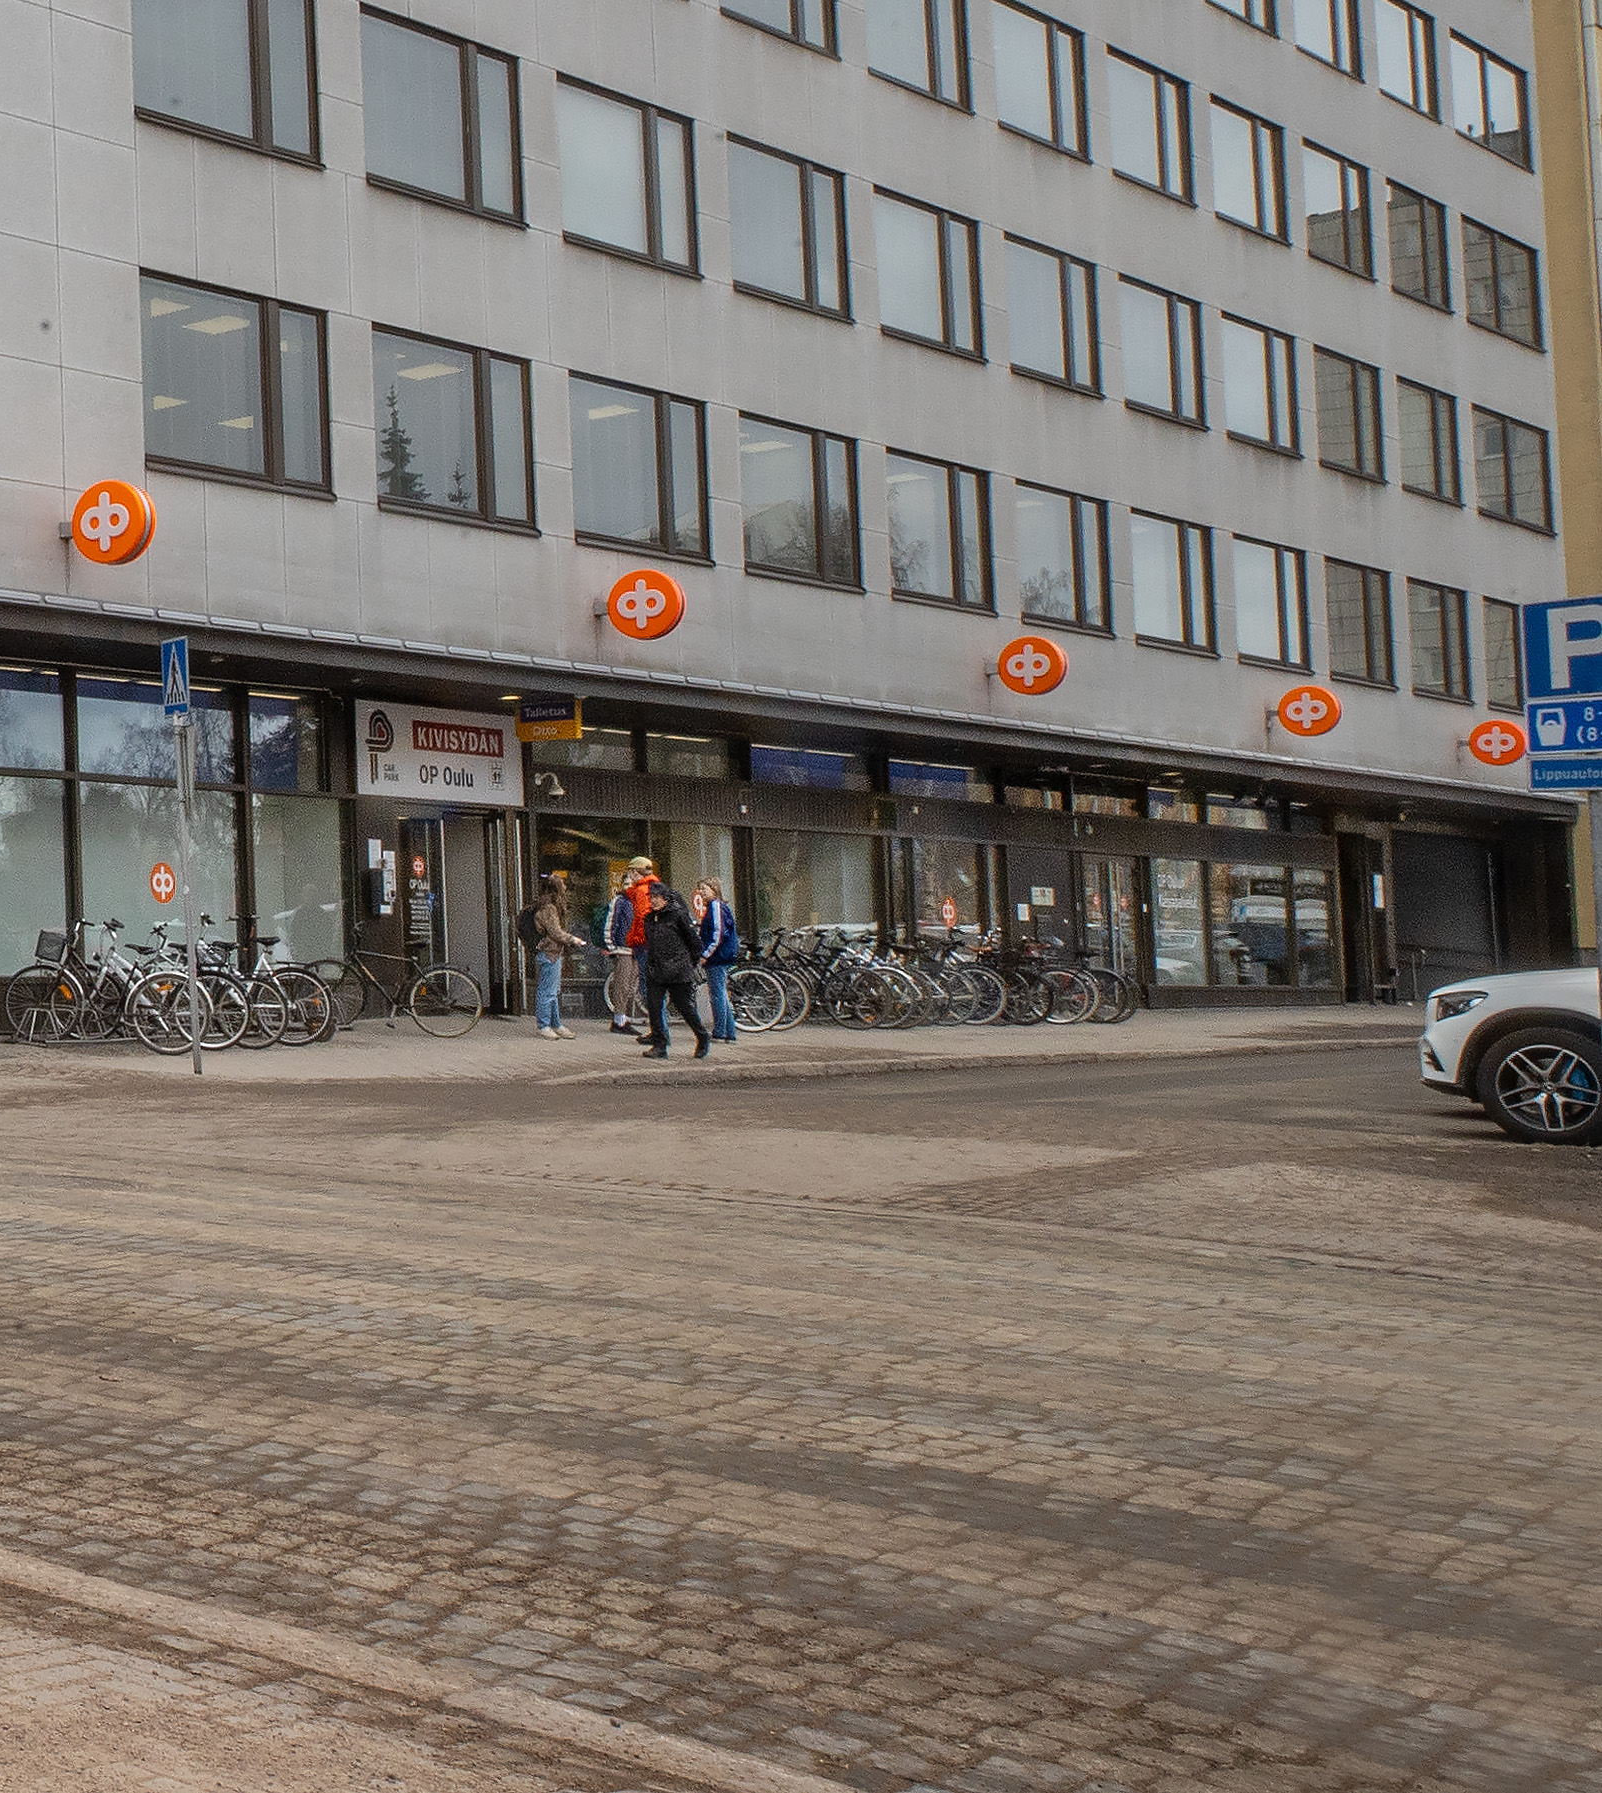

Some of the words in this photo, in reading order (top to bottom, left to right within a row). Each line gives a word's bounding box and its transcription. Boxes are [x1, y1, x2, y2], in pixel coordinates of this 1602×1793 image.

[1546, 603, 1602, 690] P
[416, 726, 500, 755] KIVISYDÄN
[419, 764, 439, 785] OP
[443, 765, 475, 788] Oulu
[1535, 767, 1602, 781] Lippuauto
